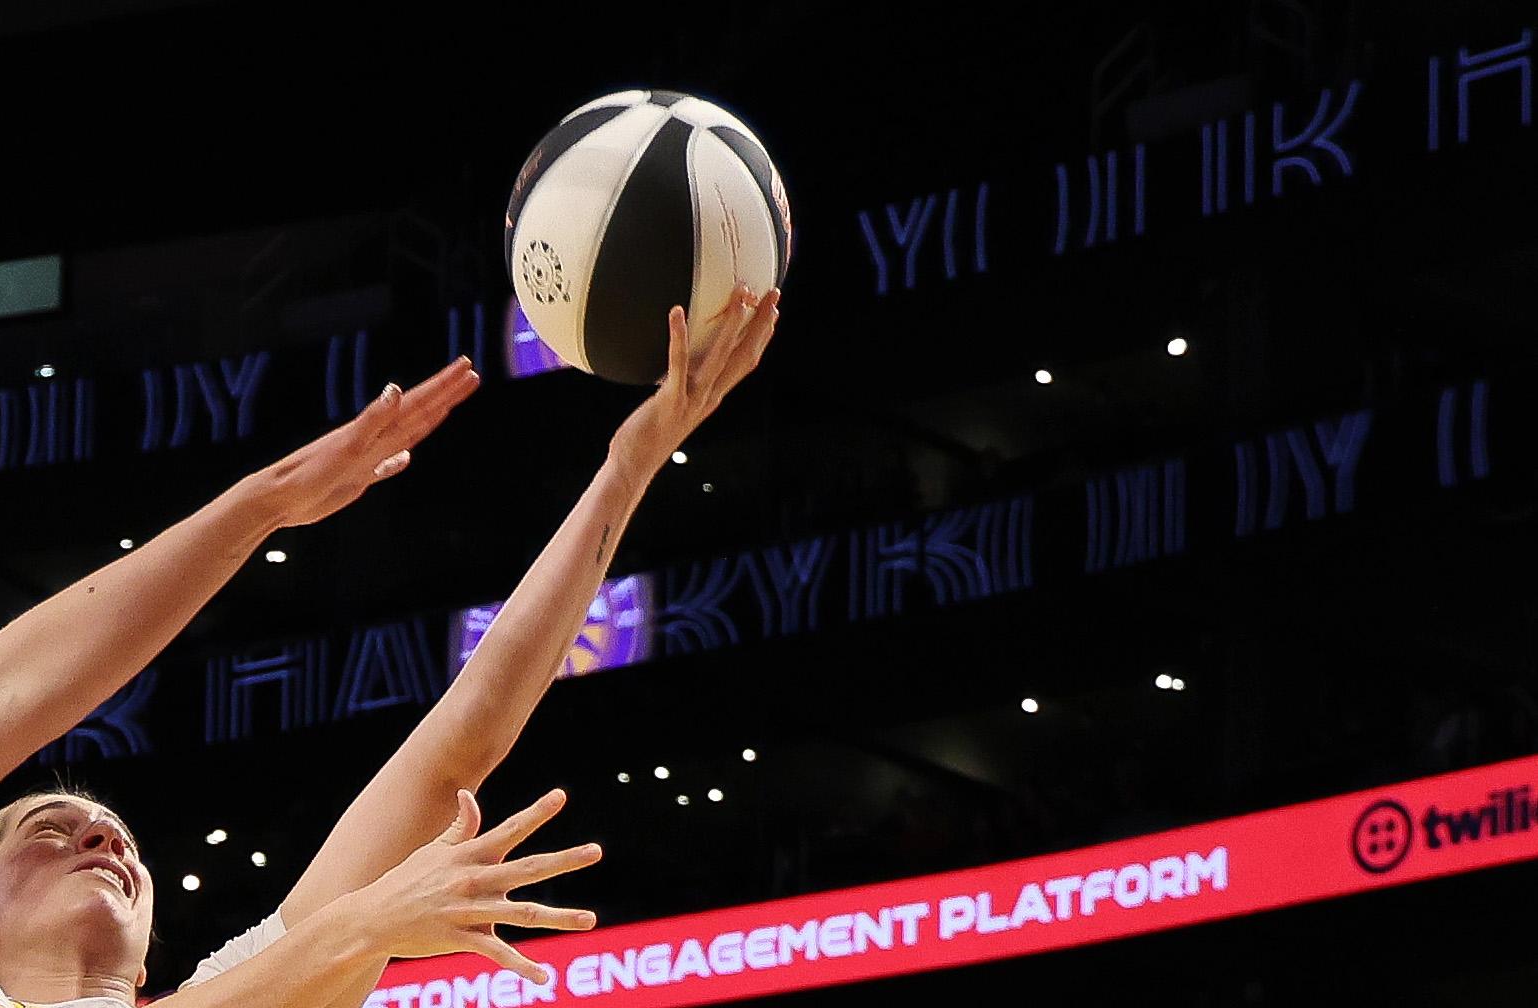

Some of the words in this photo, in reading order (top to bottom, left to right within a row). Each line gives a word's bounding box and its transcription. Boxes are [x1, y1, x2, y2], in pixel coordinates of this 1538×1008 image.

[1423, 785, 1538, 849] twili
[565, 901, 930, 998] ENGAGEMENT
[938, 846, 1229, 940] PLATFORM
